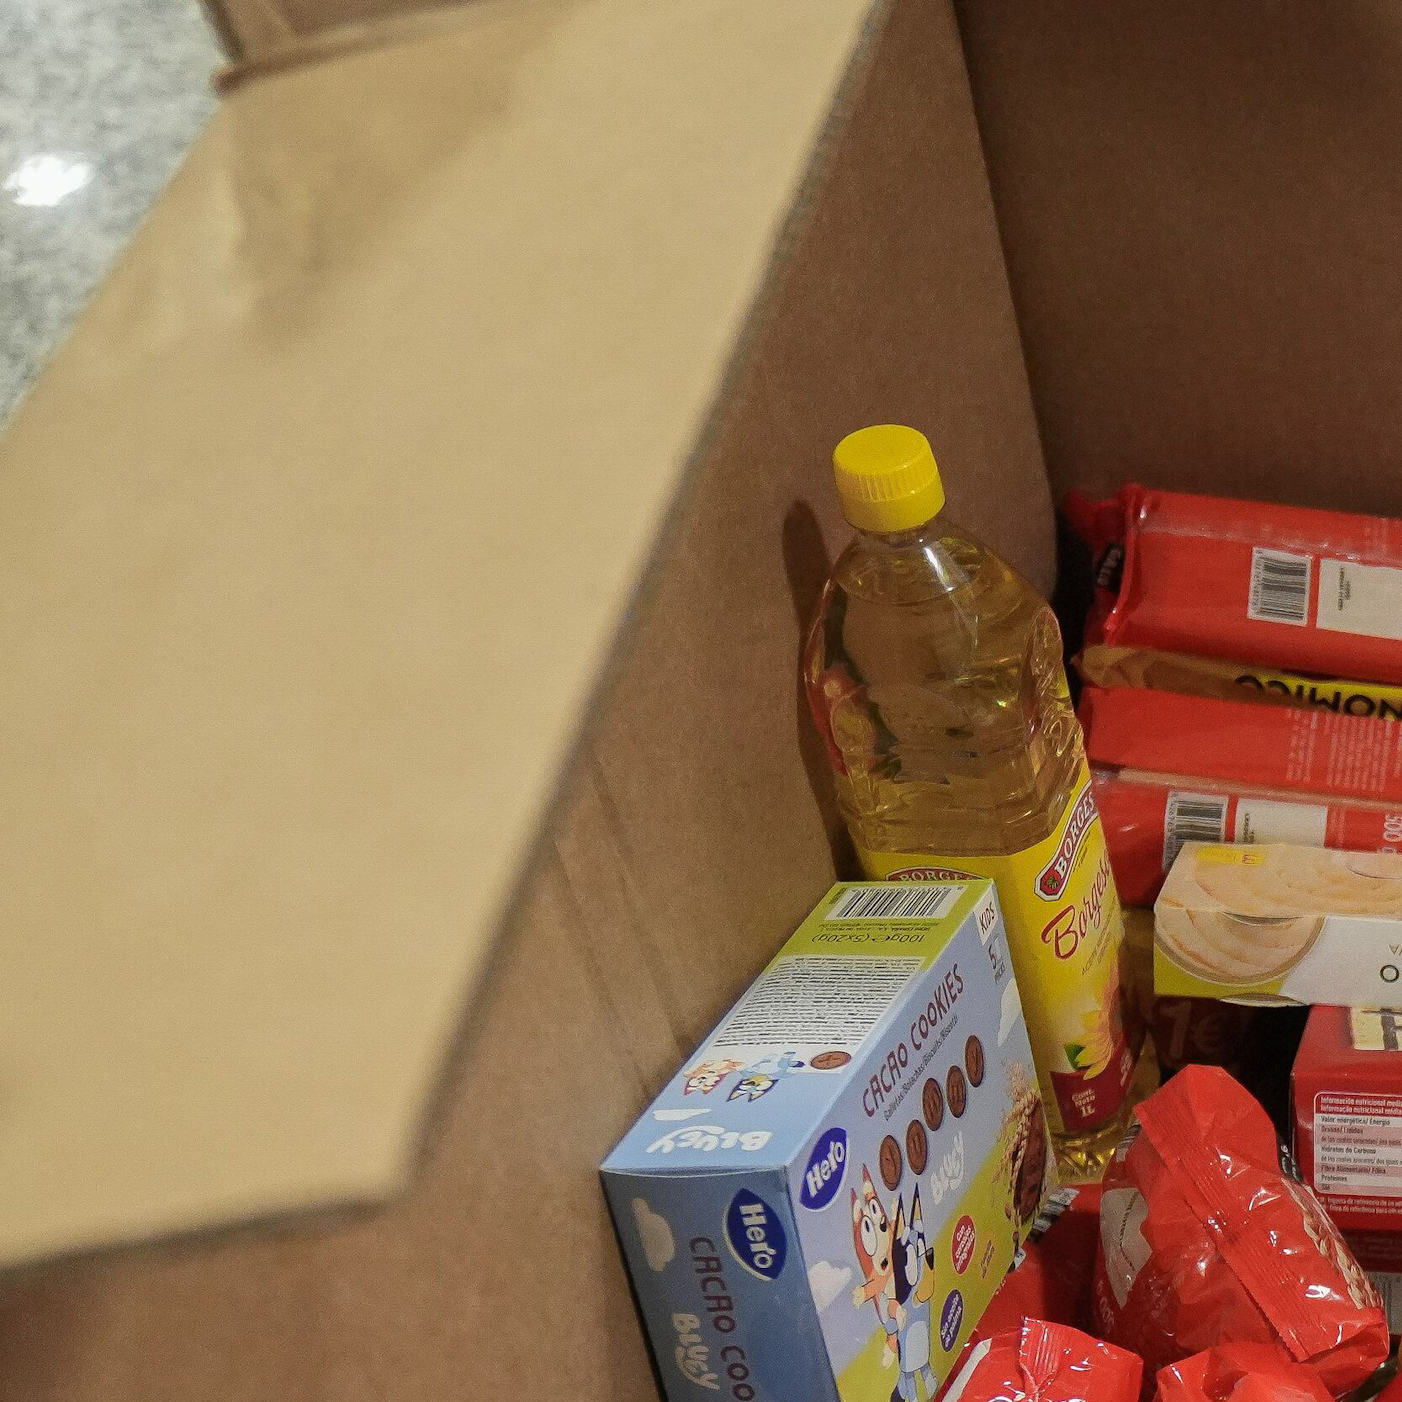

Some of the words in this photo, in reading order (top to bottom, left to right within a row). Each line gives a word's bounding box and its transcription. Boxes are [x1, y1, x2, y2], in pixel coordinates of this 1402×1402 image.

[979, 901, 996, 934] KIDS
[910, 962, 965, 1051] COOKIES
[862, 1042, 908, 1118] CACAO
[806, 1141, 846, 1198] Hero
[740, 1202, 778, 1272] Hero
[689, 1236, 738, 1335] CACAO
